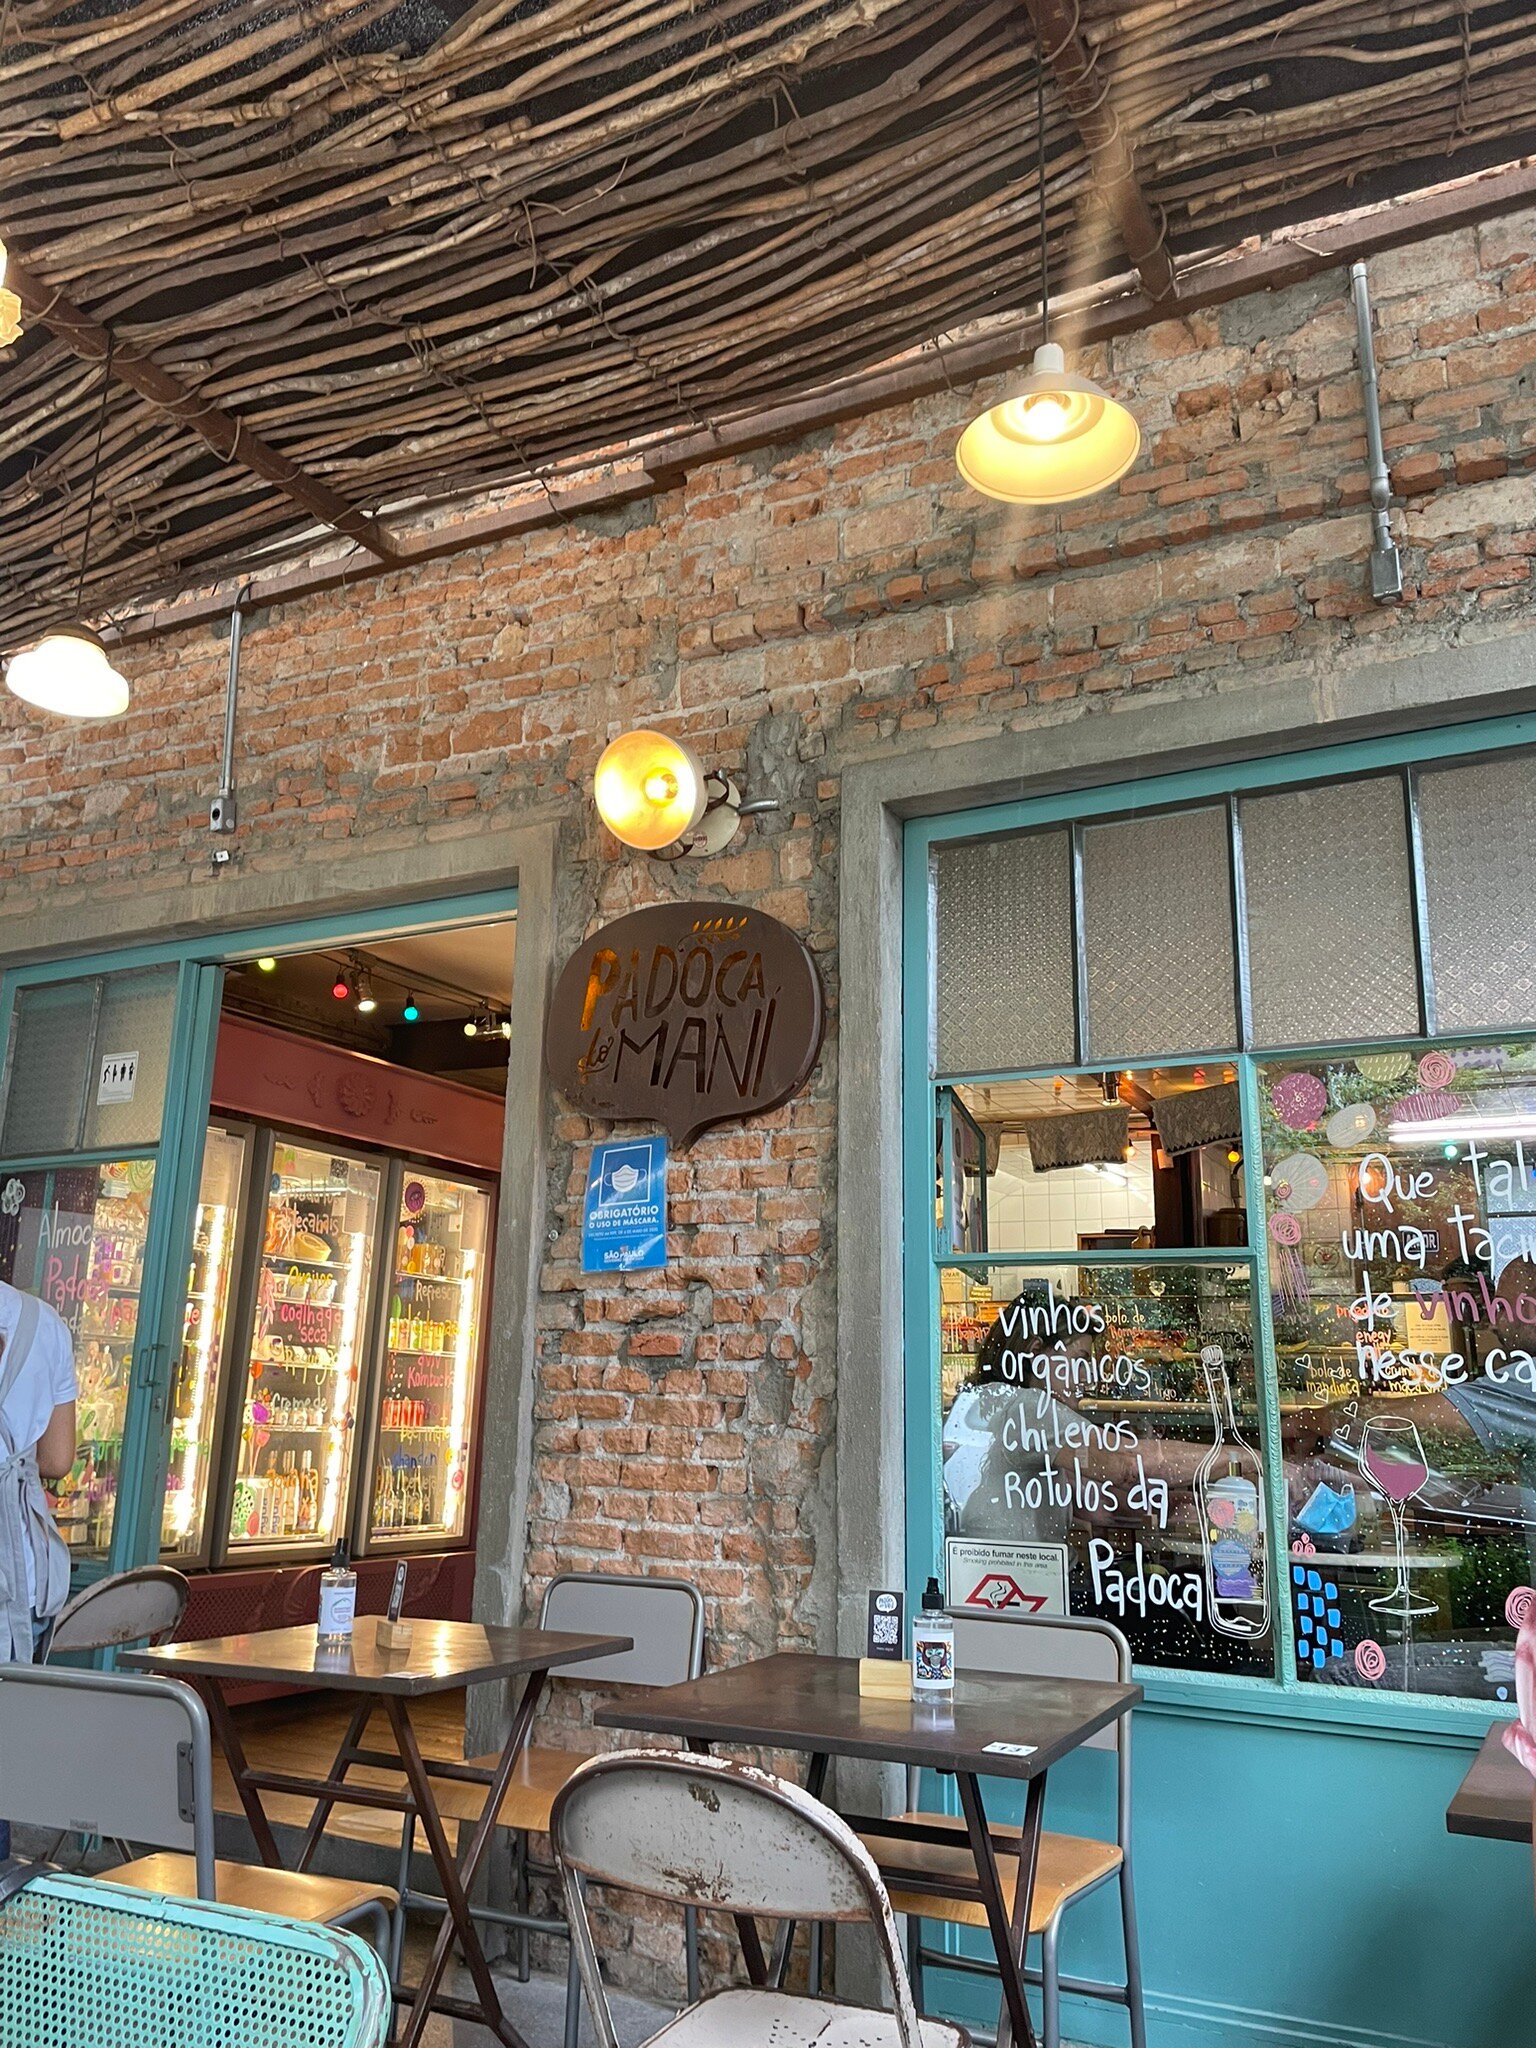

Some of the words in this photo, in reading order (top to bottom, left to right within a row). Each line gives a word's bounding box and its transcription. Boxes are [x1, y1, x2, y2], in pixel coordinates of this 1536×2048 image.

[580, 944, 766, 1030] PADOCA
[1359, 1153, 1438, 1213] Que
[1462, 1140, 1529, 1210] tal
[589, 1204, 659, 1220] OBRIGATÓRIO
[596, 1220, 611, 1228] USO
[613, 1219, 621, 1227] DE
[623, 1216, 660, 1226] MÁSCARA.
[1342, 1225, 1427, 1270] uma
[999, 1282, 1106, 1340] vinhos
[1133, 1304, 1146, 1325] de
[1350, 1271, 1400, 1332] de
[300, 1326, 328, 1345] seca
[1356, 1341, 1469, 1388] nesse
[1003, 1398, 1139, 1453] chilenos
[1127, 1454, 1168, 1529] da
[960, 1548, 990, 1557] proibido
[992, 1550, 1014, 1558] fumar
[1016, 1551, 1037, 1560] neste
[1089, 1538, 1202, 1621] Padoca
